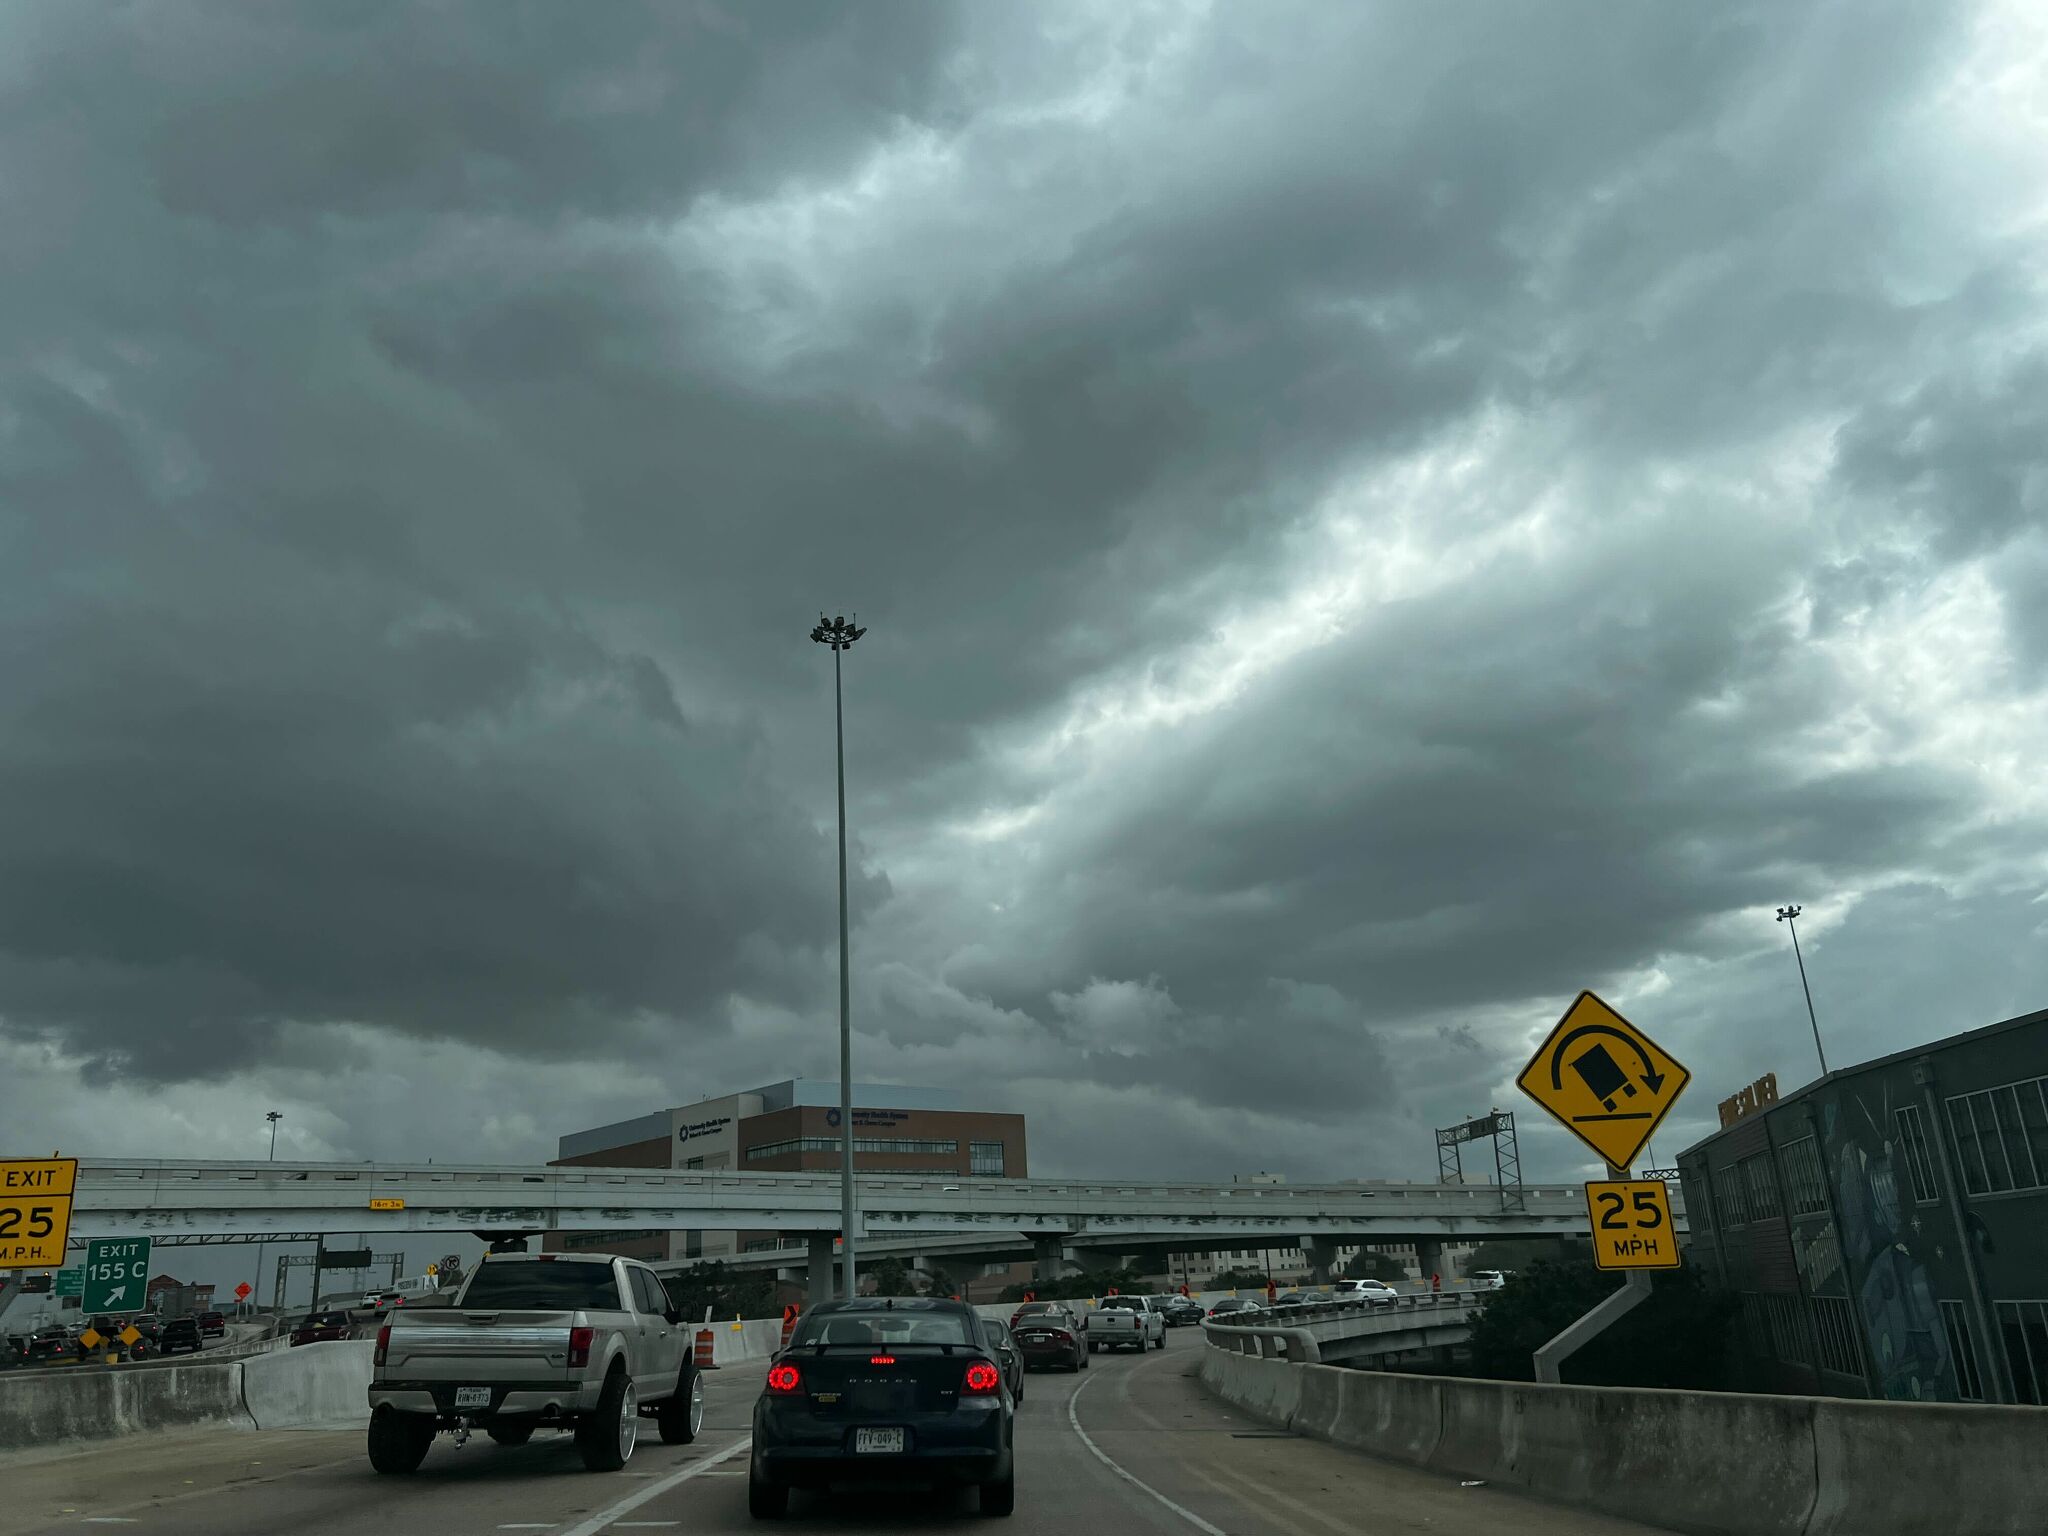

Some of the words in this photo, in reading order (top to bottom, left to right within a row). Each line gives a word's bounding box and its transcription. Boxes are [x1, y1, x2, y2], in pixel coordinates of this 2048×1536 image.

[6, 1170, 56, 1187] EXIT
[1597, 1191, 1662, 1229] 25
[0, 1206, 53, 1238] 25
[99, 1244, 139, 1258] EXIT
[1614, 1239, 1659, 1256] MPH
[89, 1262, 125, 1281] 155
[131, 1261, 146, 1278] C
